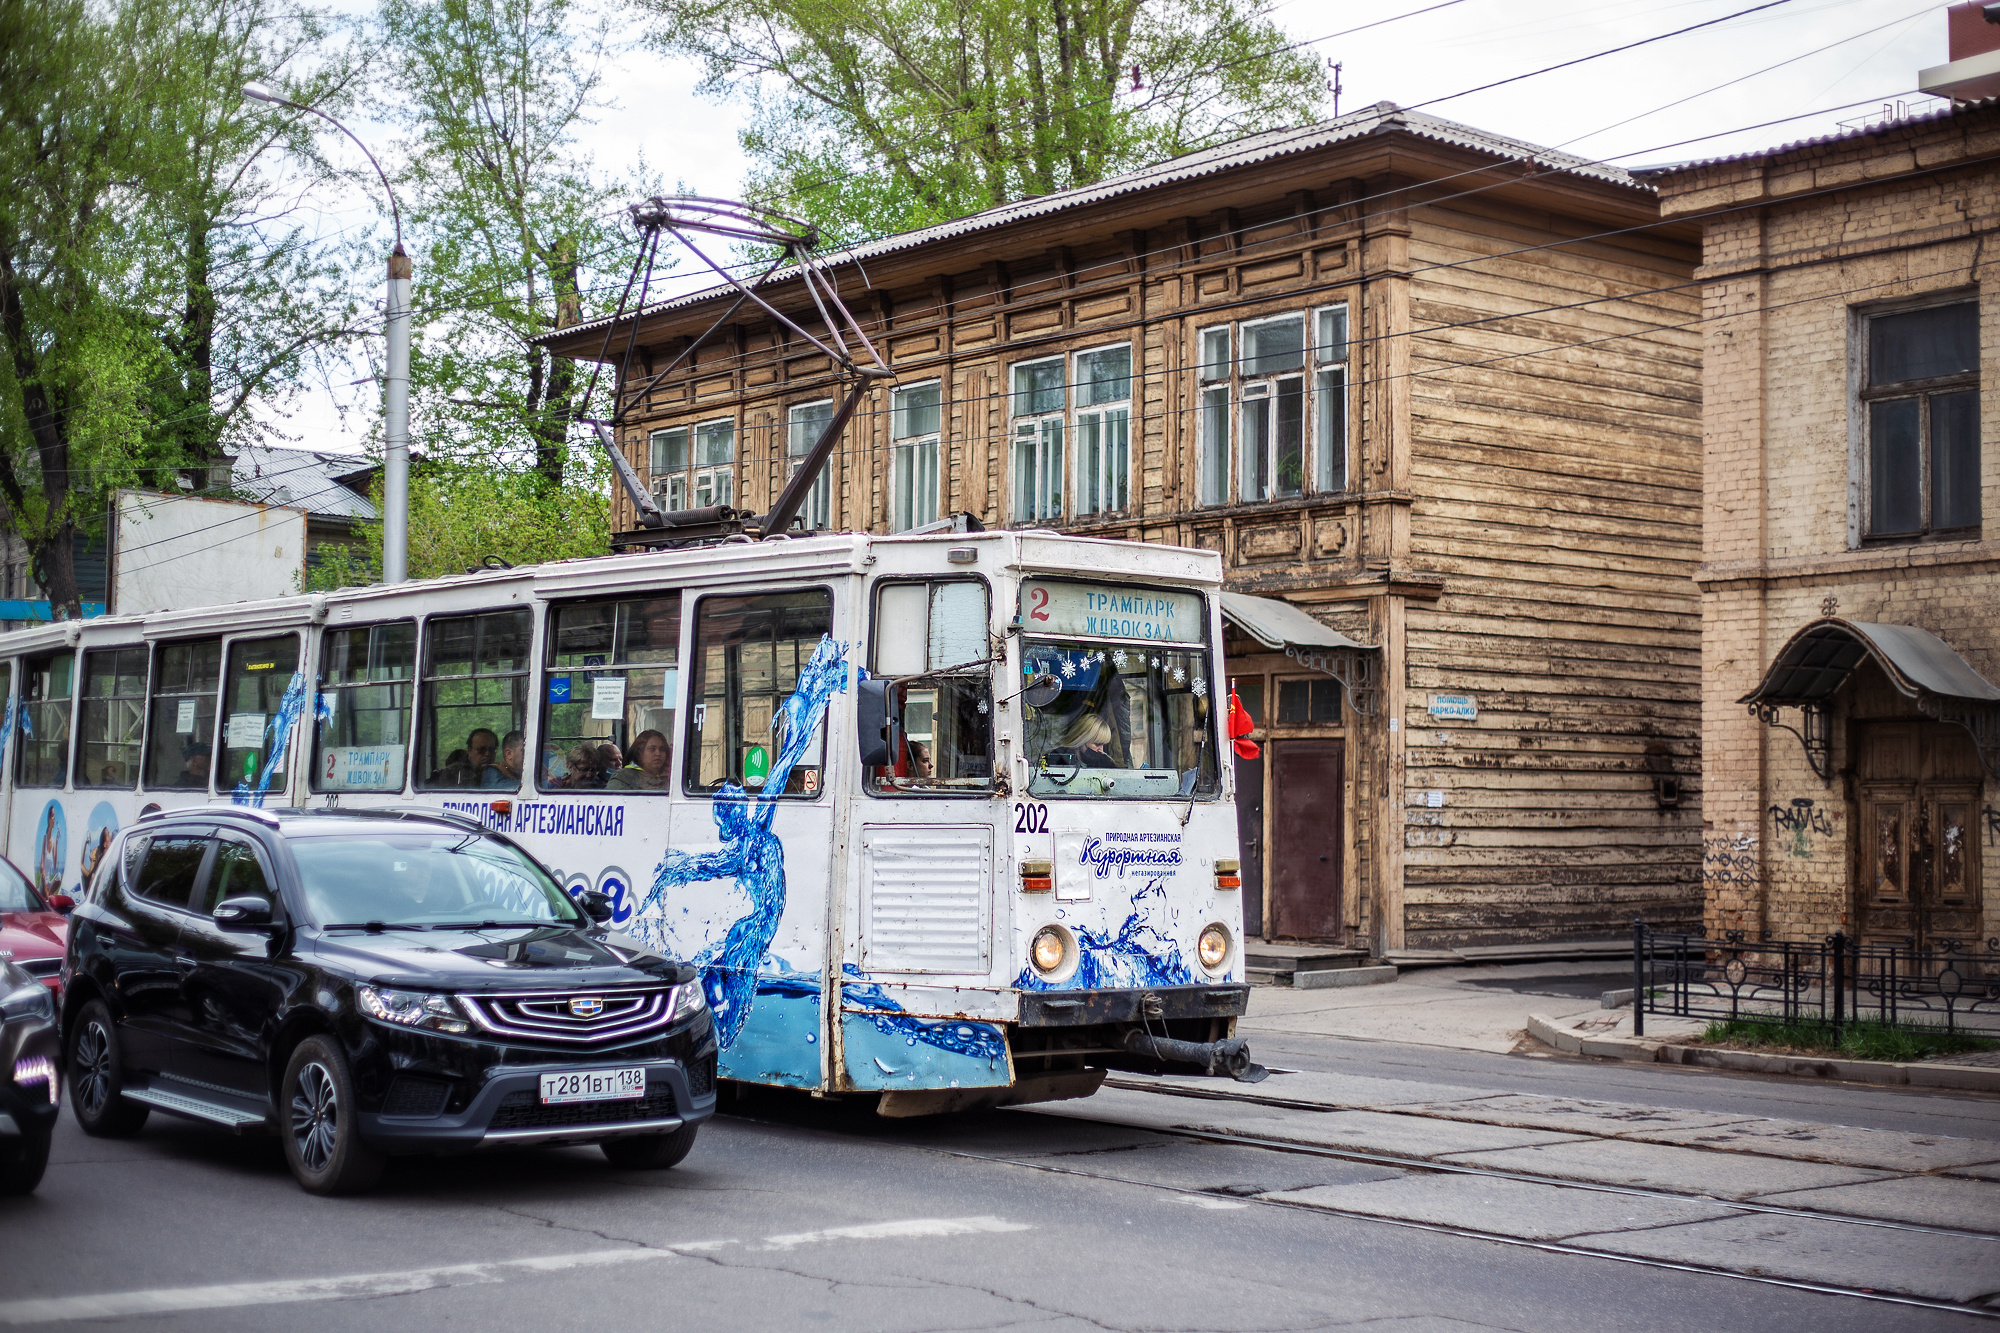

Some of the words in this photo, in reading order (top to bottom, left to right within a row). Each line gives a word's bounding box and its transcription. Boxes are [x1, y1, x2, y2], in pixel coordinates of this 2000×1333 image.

[1030, 587, 1050, 622] 2
[1086, 592, 1175, 619] ТРАМПАРК
[1430, 706, 1475, 715] НАРКО-АЛКО
[1436, 696, 1468, 705] ПОМОЩЬ
[326, 753, 336, 779] 2
[348, 751, 390, 766] ТРАМПАРК
[514, 803, 625, 837] АРТЕЗИАНСКАЯ
[1014, 802, 1049, 834] 202
[1105, 832, 1139, 843] ПРИРОДНАЯ
[1139, 833, 1182, 843] АРТЕЗИАНСКАЯ
[1080, 837, 1183, 878] Курортная
[617, 1069, 641, 1086] 138
